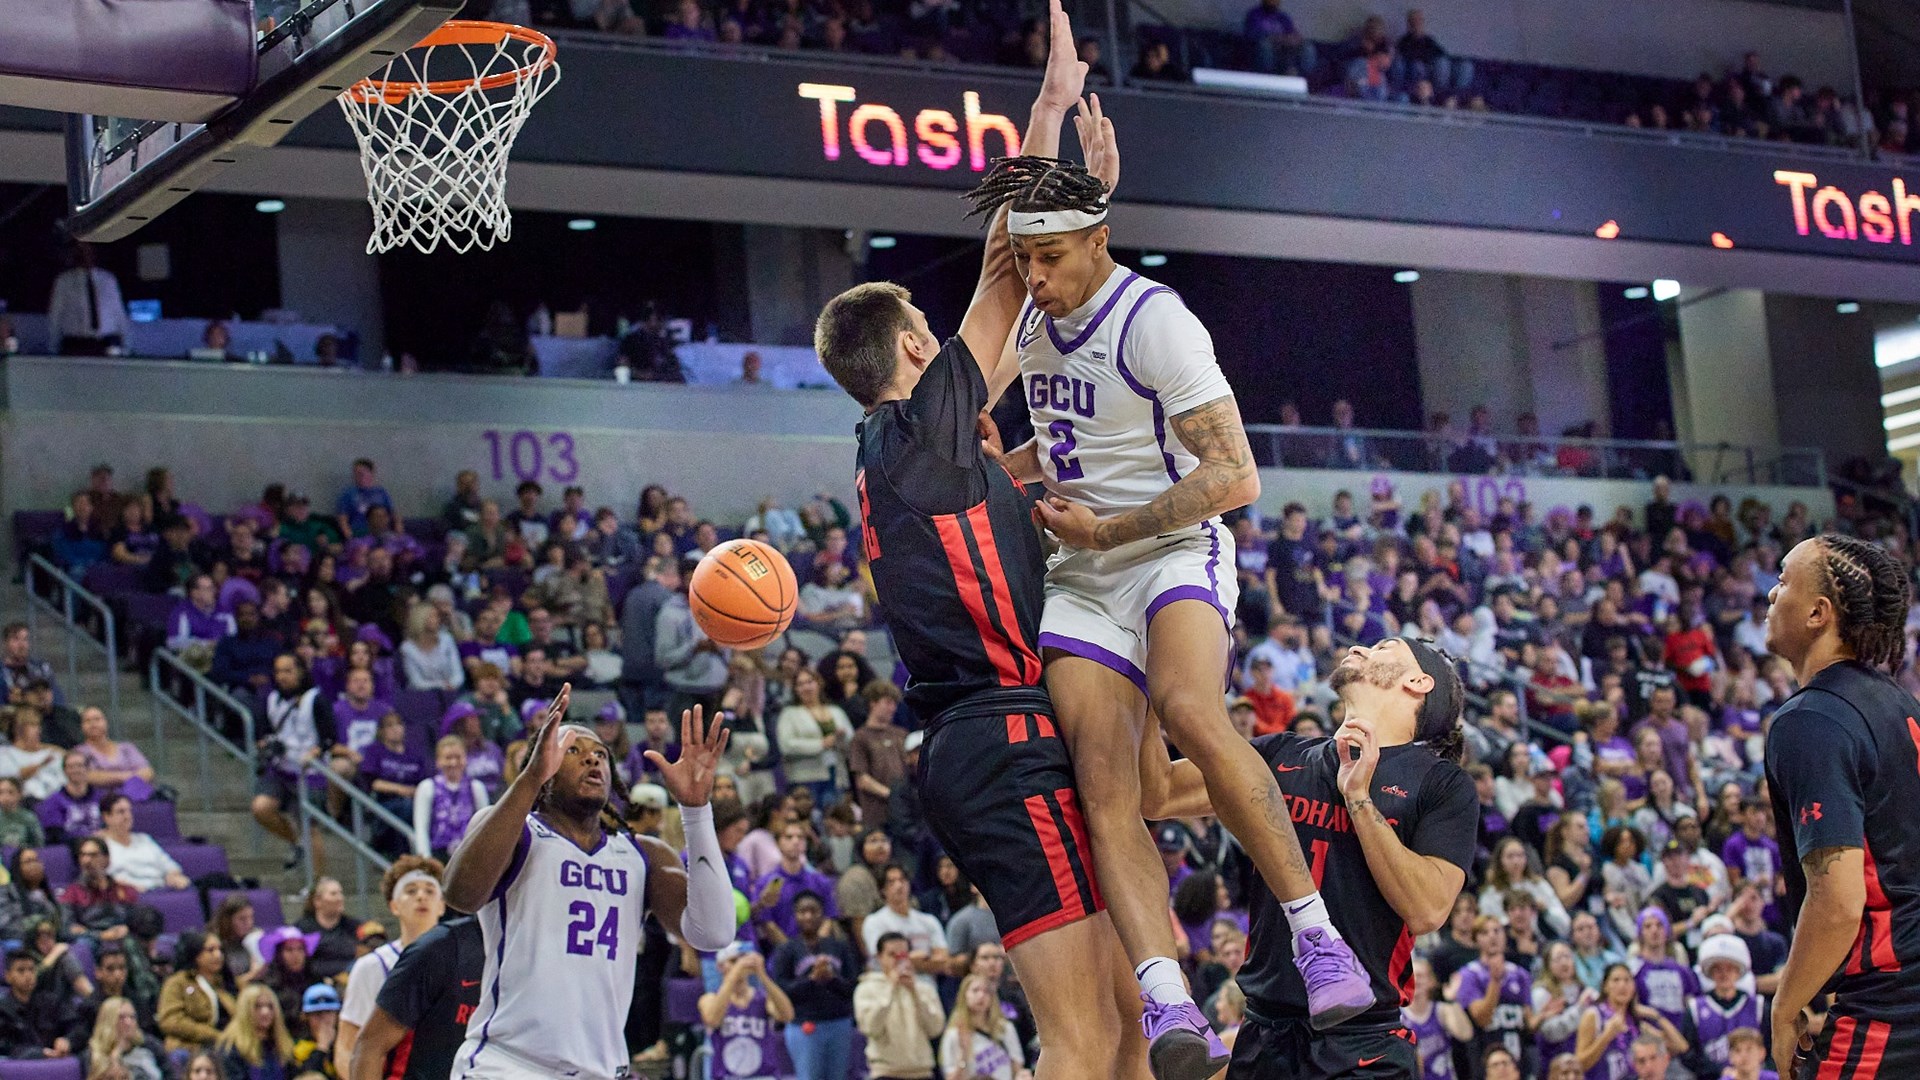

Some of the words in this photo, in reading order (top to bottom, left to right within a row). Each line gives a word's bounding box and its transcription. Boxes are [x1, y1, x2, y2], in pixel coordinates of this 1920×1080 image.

[1030, 373, 1095, 418] GCU
[483, 431, 580, 483] 103
[1048, 419, 1084, 482] 2
[560, 860, 627, 896] GCU
[1310, 838, 1329, 892] 1
[566, 900, 619, 961] 24
